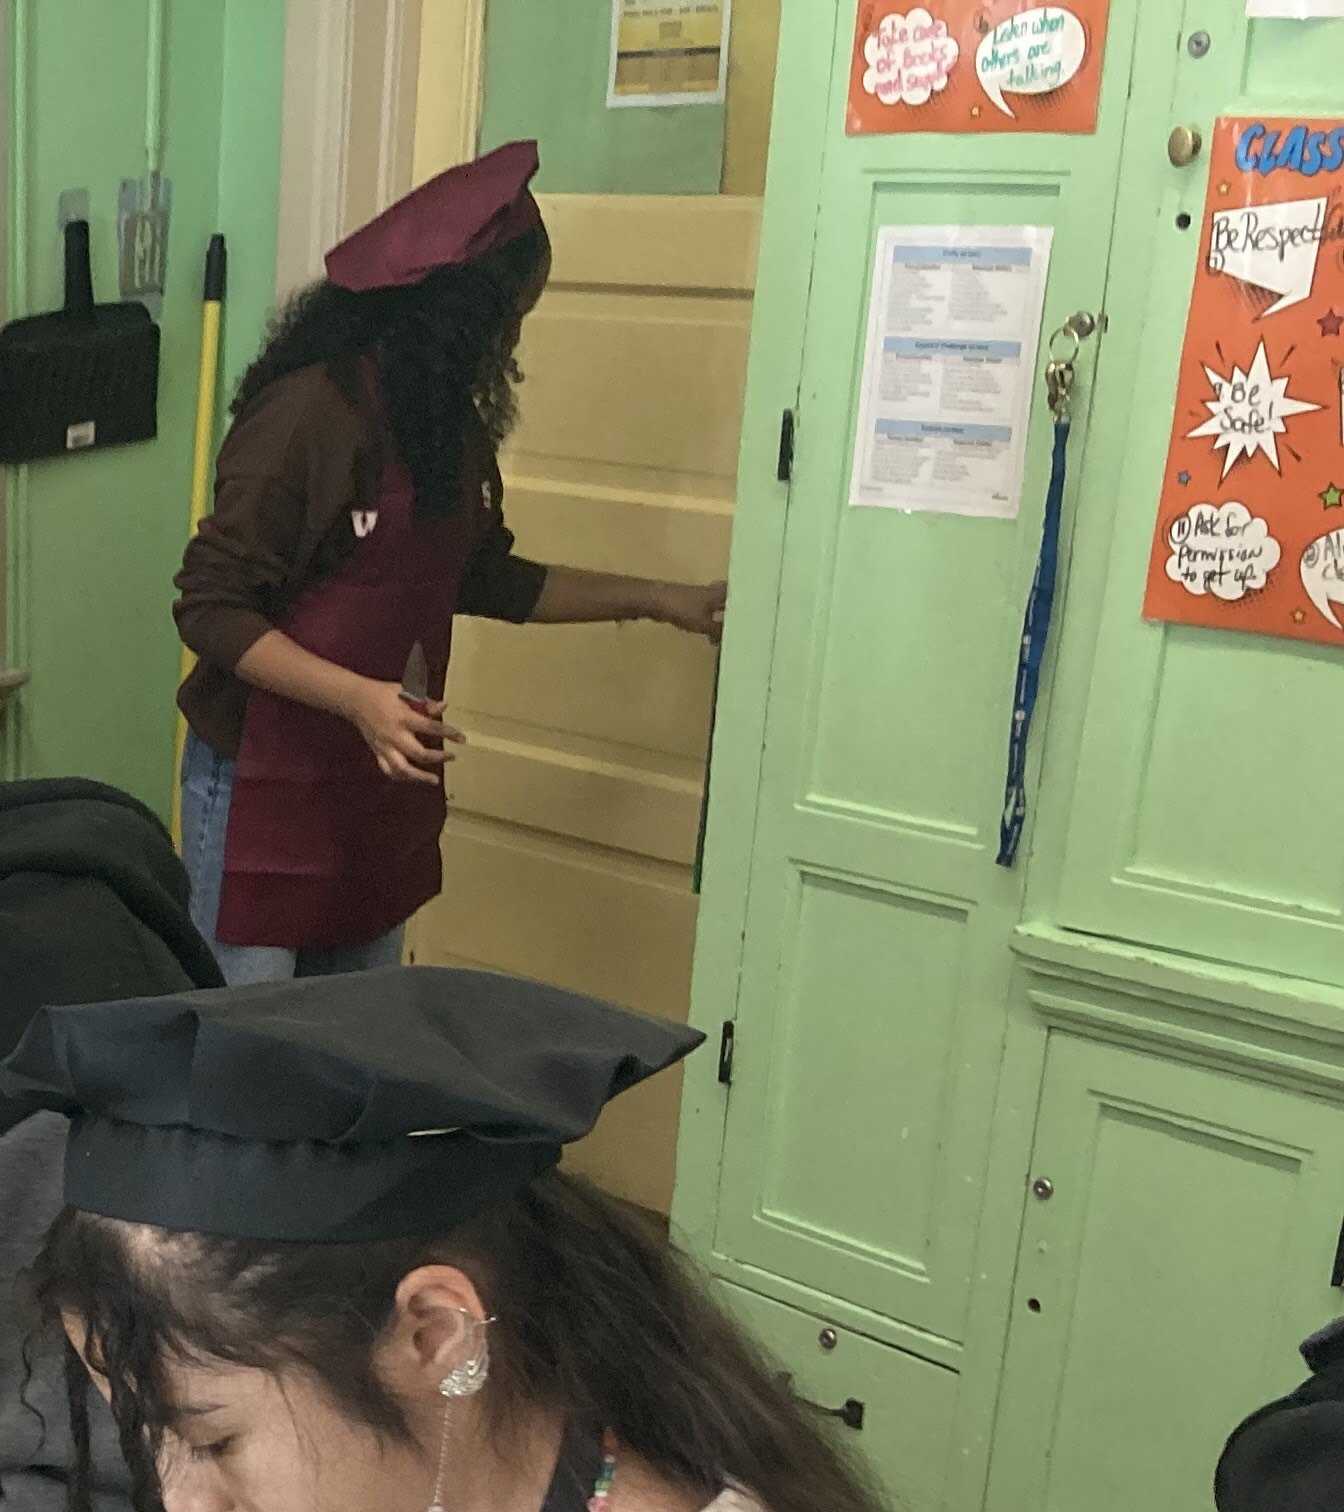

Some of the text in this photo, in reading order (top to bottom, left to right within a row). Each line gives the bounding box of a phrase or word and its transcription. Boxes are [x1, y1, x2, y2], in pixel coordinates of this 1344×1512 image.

[1214, 216, 1239, 251] Be
[1230, 380, 1261, 407] Be
[1219, 401, 1274, 435] Safe!
[1194, 512, 1222, 538] Ask
